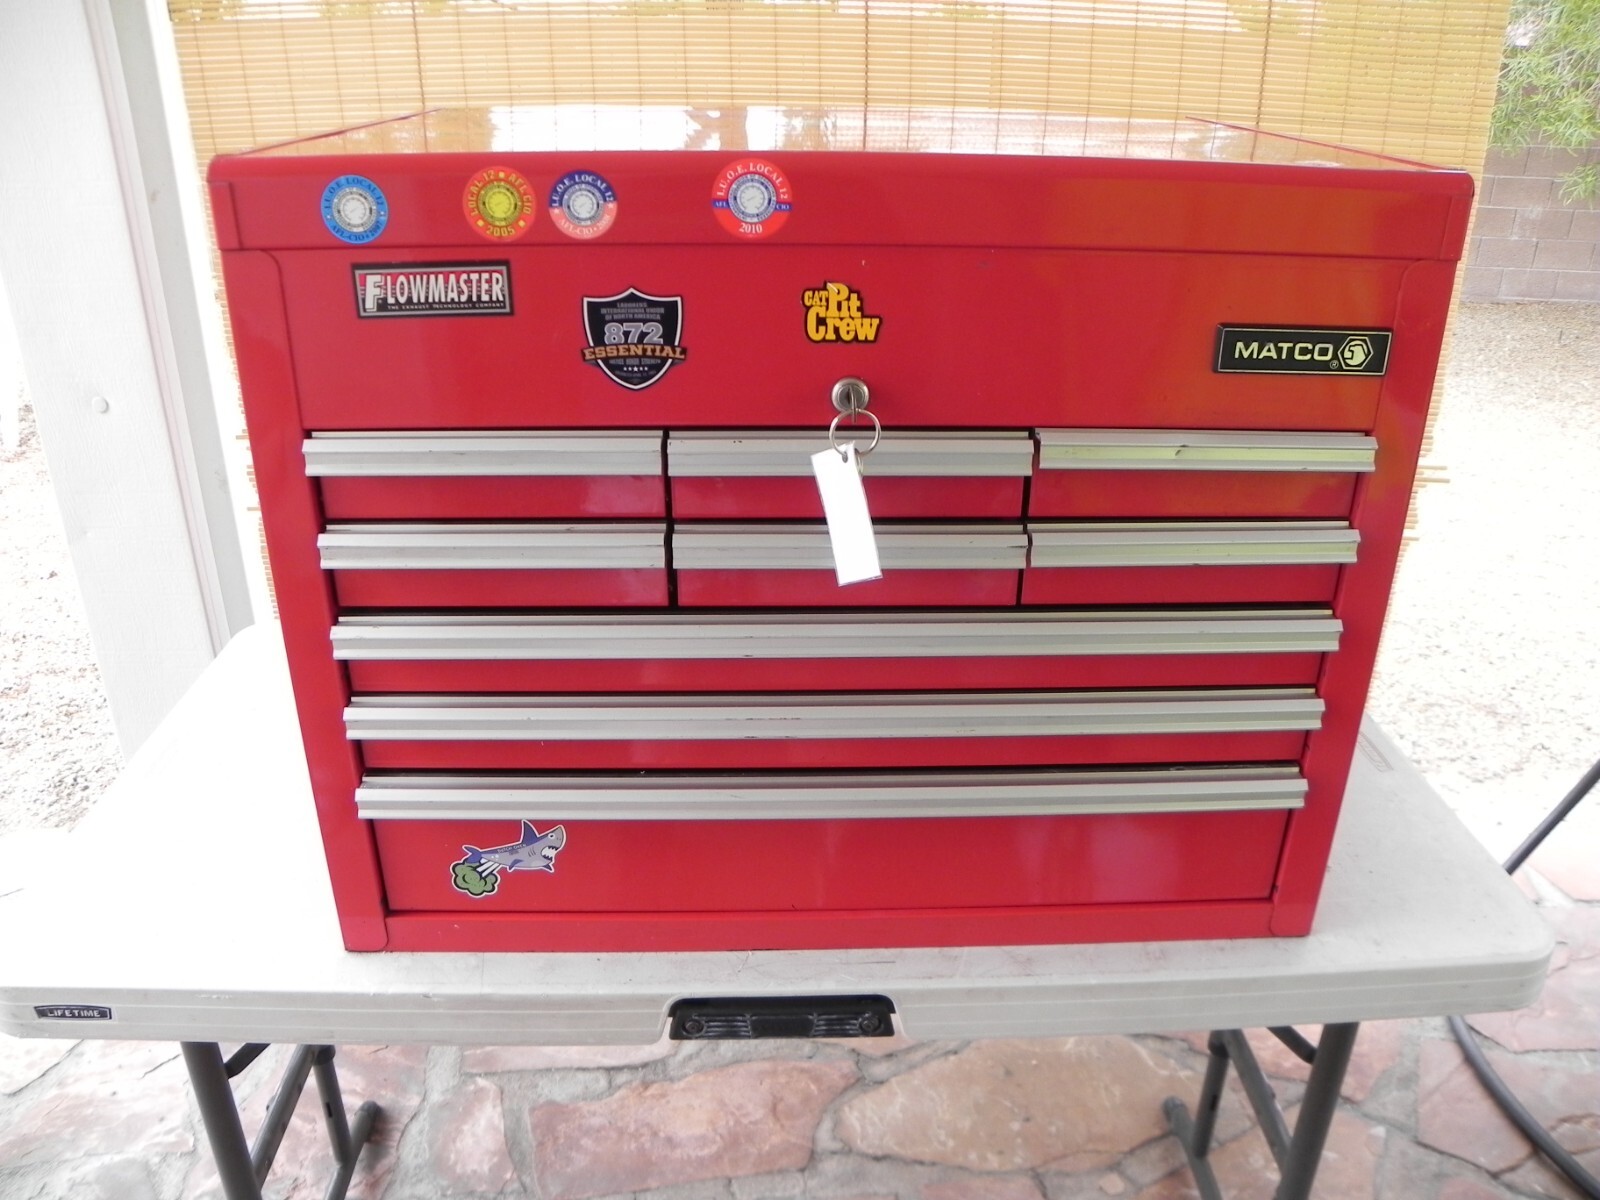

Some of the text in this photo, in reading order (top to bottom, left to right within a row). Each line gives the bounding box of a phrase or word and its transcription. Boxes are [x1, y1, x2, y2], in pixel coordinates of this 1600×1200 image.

[345, 177, 378, 195] LOCAL
[574, 174, 607, 192] LOCAL
[605, 191, 614, 202] 12
[749, 162, 783, 187] LOCAL
[779, 187, 788, 199] 12
[468, 180, 484, 217] LOCAL
[482, 170, 495, 182] 12
[486, 225, 516, 237] 2005
[739, 222, 763, 234] 2010
[365, 272, 504, 311] FLOWMASTER
[804, 290, 829, 306] CAT
[826, 282, 862, 318] Pit
[604, 322, 664, 345] 872
[807, 305, 880, 341] Crew
[583, 344, 686, 360] ESSENTIAL
[1234, 341, 1334, 361] MATCO
[47, 1009, 101, 1018] LIFETIME
